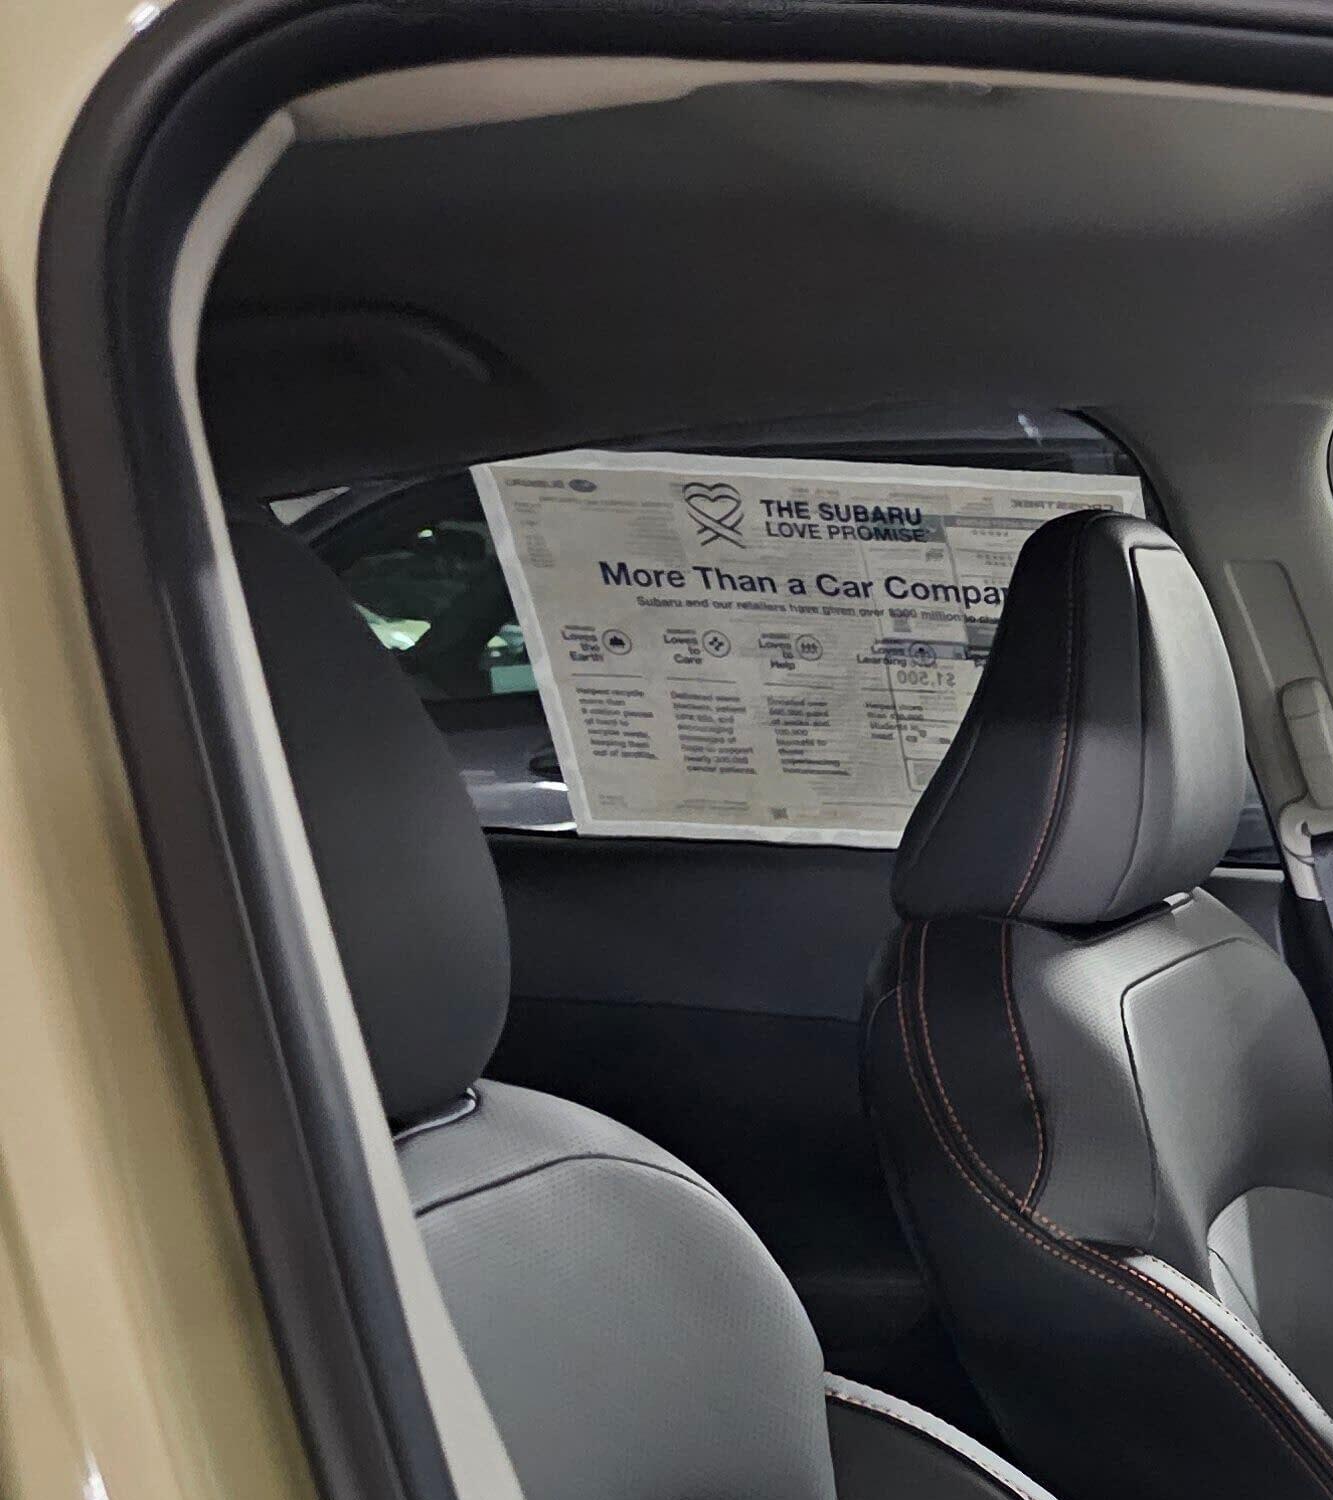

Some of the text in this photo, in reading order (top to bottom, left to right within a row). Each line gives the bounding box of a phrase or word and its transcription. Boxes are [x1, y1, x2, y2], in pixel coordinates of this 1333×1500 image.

[760, 500, 922, 526] THE SUBARU
[766, 521, 927, 542] LOVE PROMISE
[600, 561, 1008, 609] More Than a Car Compa
[637, 596, 683, 608] Subaru
[686, 597, 709, 608] and
[712, 600, 732, 609] our
[736, 600, 787, 612] retailers
[921, 610, 960, 621] million
